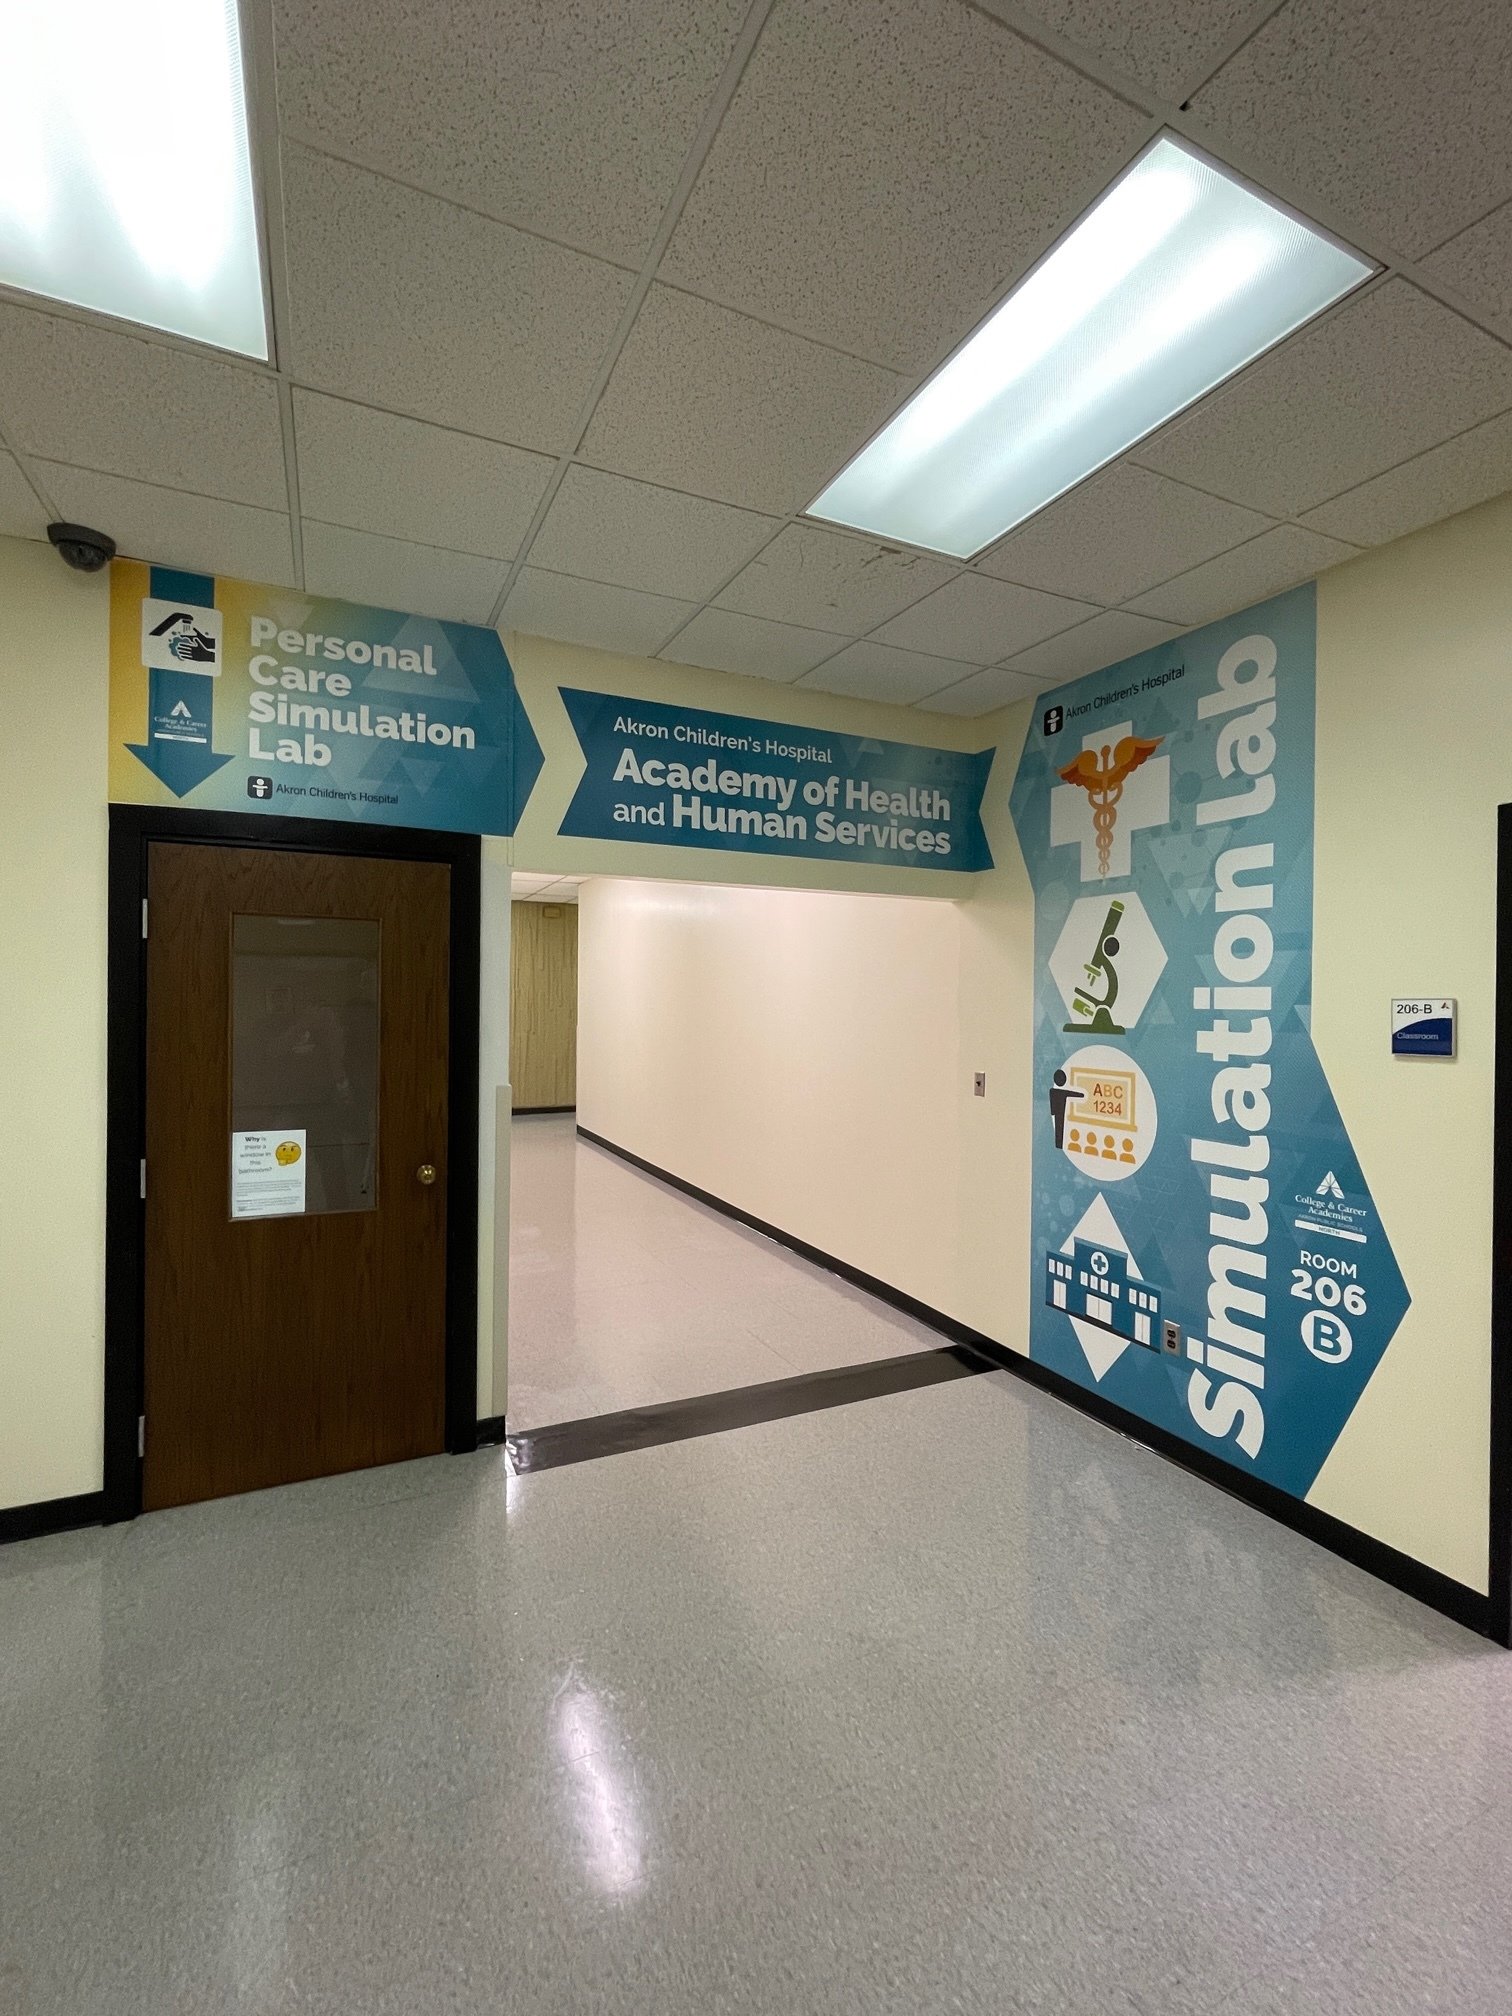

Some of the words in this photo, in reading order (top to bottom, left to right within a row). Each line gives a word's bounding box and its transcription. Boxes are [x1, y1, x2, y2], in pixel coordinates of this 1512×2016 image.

[250, 615, 437, 676] Personal
[248, 655, 352, 698] Care
[1065, 703, 1092, 719] Akron
[1093, 684, 1140, 709] Children's
[1142, 664, 1185, 691] Hospital
[248, 691, 475, 750] Simulation
[613, 716, 669, 739] Akron
[673, 725, 761, 754] Children's
[765, 740, 832, 764] Hospital
[248, 727, 332, 767] Lab
[276, 783, 306, 796] Akron
[309, 787, 357, 801] Children's
[359, 792, 399, 805] Hospital
[612, 747, 798, 811] Academy
[802, 775, 840, 808] of
[845, 779, 951, 822] Health
[613, 801, 665, 826] and
[672, 793, 807, 841] Human
[814, 811, 951, 855] Services
[1396, 1004, 1433, 1014] 206-B
[1396, 1032, 1439, 1040] Classroom
[1093, 1083, 1123, 1099] ABC
[1093, 1100, 1122, 1116] 1234
[1187, 842, 1275, 1460] Simulation
[1295, 1194, 1326, 1208] College
[1328, 1201, 1335, 1210] &
[1337, 1203, 1367, 1217] Career
[1308, 1206, 1353, 1222] Academies
[1319, 1226, 1341, 1236] NORTH
[1300, 1250, 1357, 1279] ROOM
[1290, 1269, 1367, 1316] 206
[1313, 1315, 1342, 1356] B
